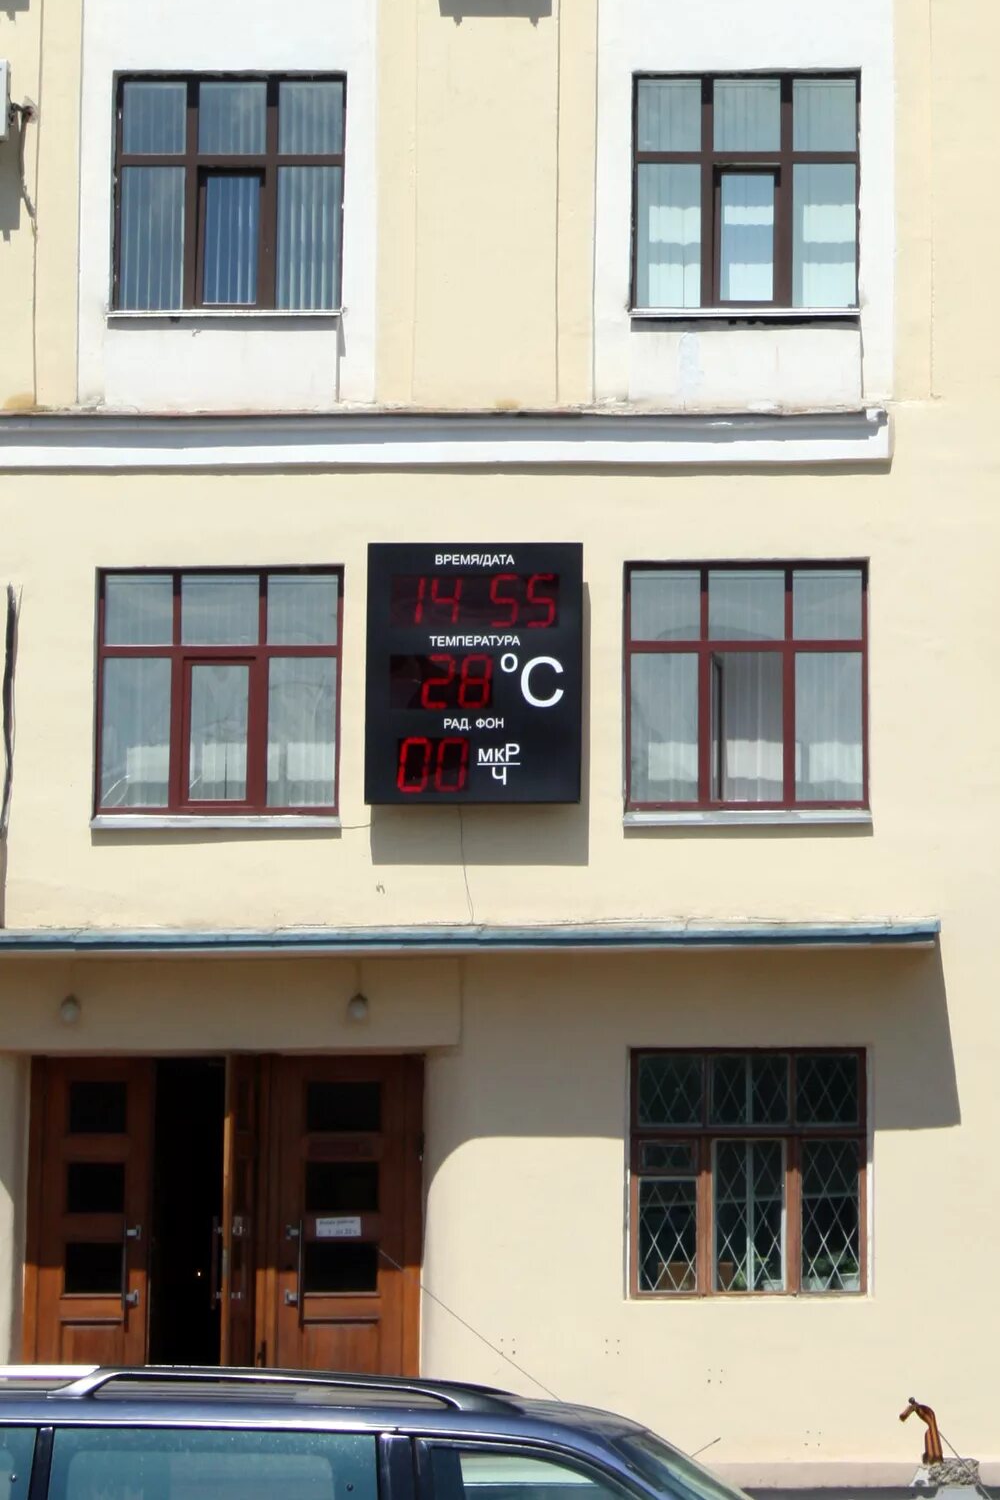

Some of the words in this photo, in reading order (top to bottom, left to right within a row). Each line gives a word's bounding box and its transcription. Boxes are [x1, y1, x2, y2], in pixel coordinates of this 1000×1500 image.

[434, 553, 515, 567] ВРЕМЯ/ДАТА
[414, 577, 463, 624] 14
[490, 573, 556, 628] 55
[429, 635, 521, 647] ТЕМПЕРАТУРА
[421, 654, 493, 709] 28
[443, 717, 472, 731] РАД.
[475, 717, 505, 730] ФОН
[396, 736, 470, 793] 00
